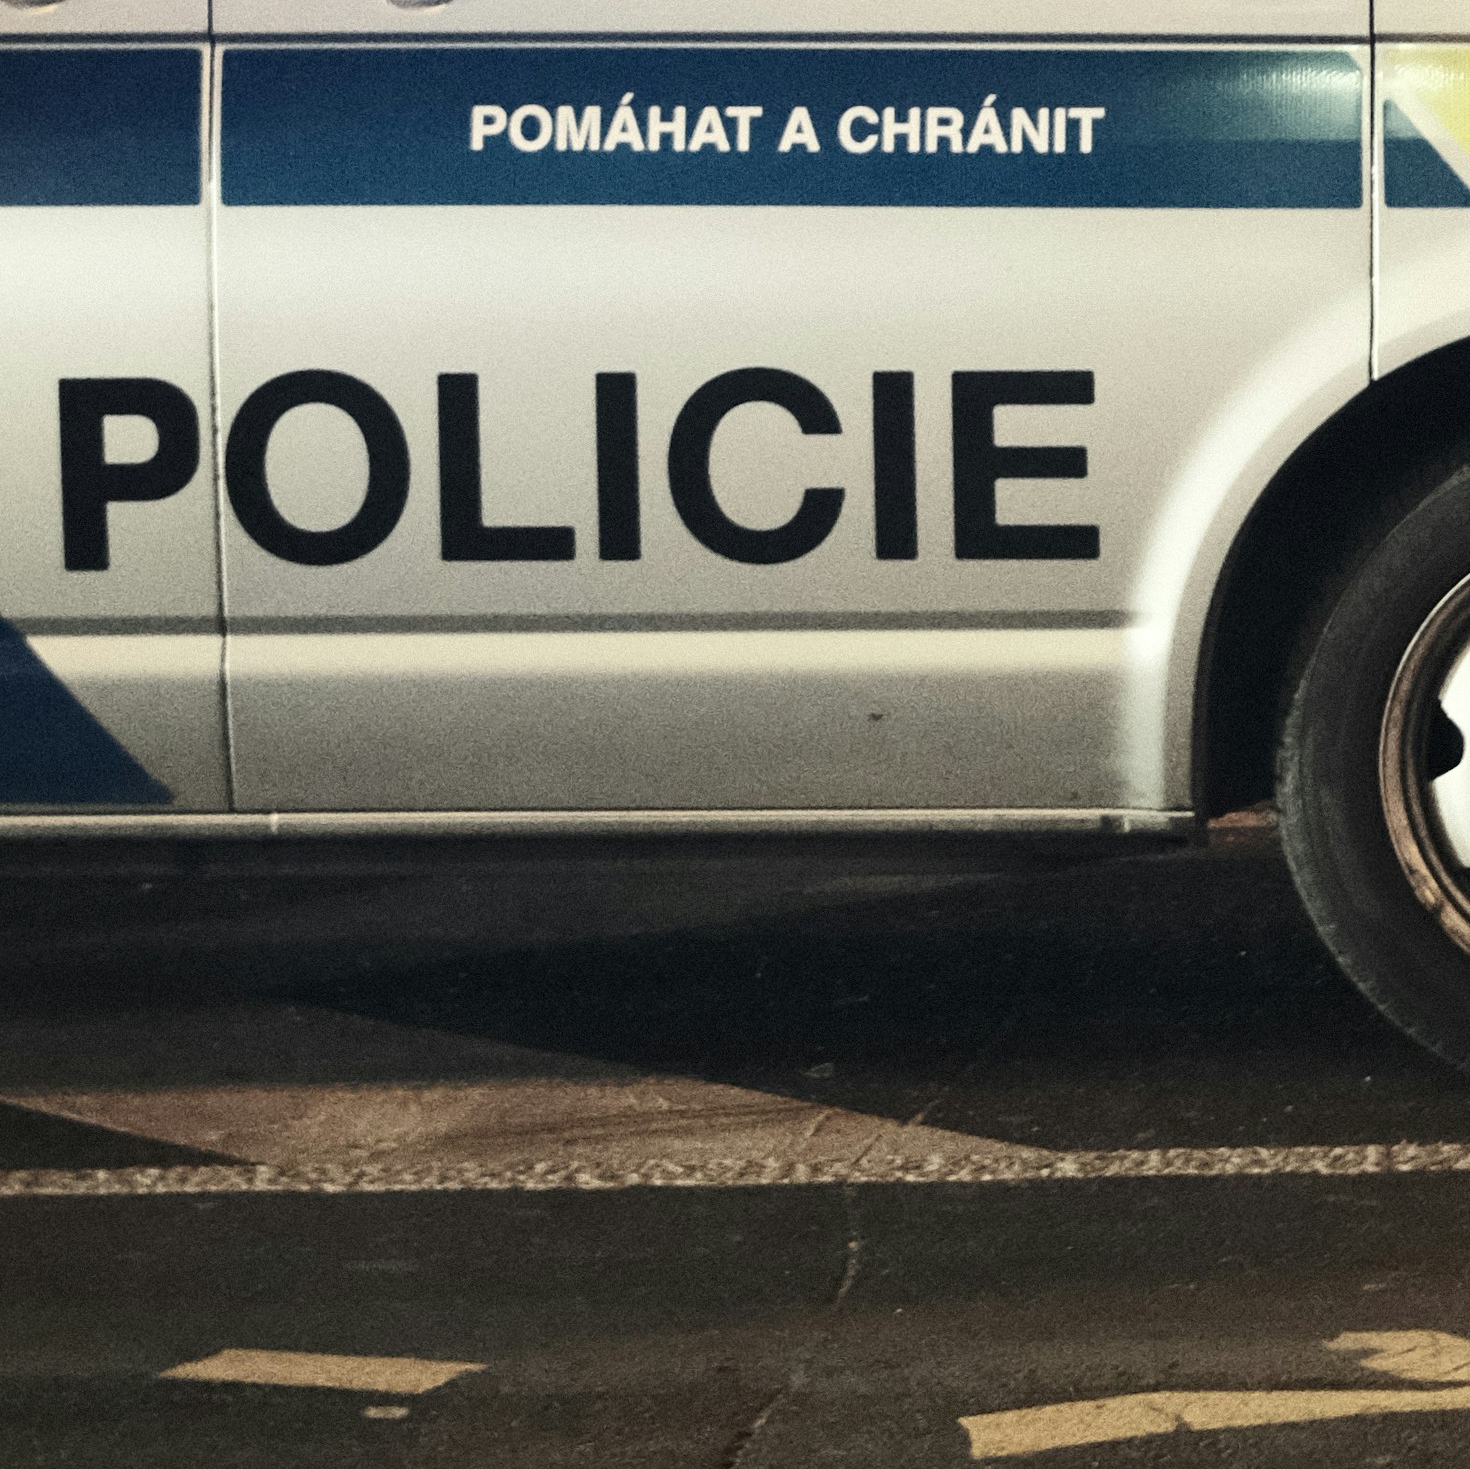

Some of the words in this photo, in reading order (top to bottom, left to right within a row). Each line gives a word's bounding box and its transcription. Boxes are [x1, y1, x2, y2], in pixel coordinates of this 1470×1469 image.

[469, 92, 763, 153] POMÁHAT
[778, 105, 821, 153] A
[837, 94, 1106, 154] CHRÁNIT
[58, 367, 1101, 572] POLICIE
